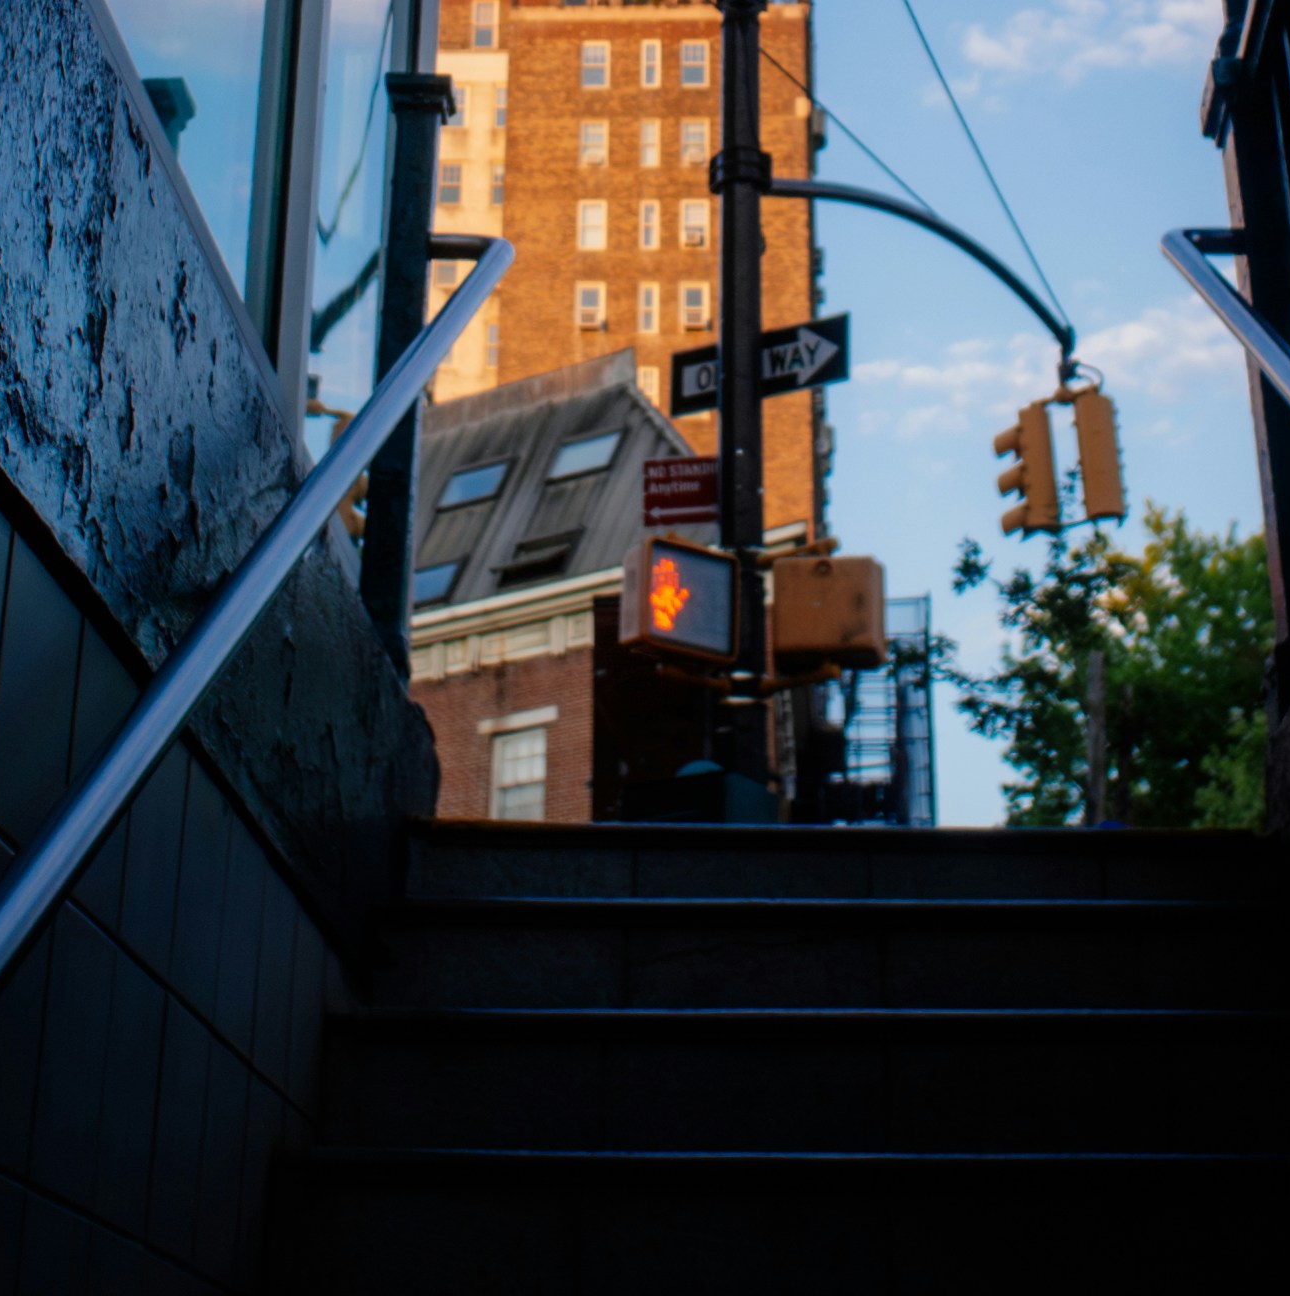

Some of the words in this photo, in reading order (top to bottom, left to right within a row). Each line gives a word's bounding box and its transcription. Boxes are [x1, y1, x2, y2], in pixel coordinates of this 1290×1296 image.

[770, 342, 821, 371] WAY
[648, 465, 667, 478] NO
[649, 480, 700, 496] Anytime
